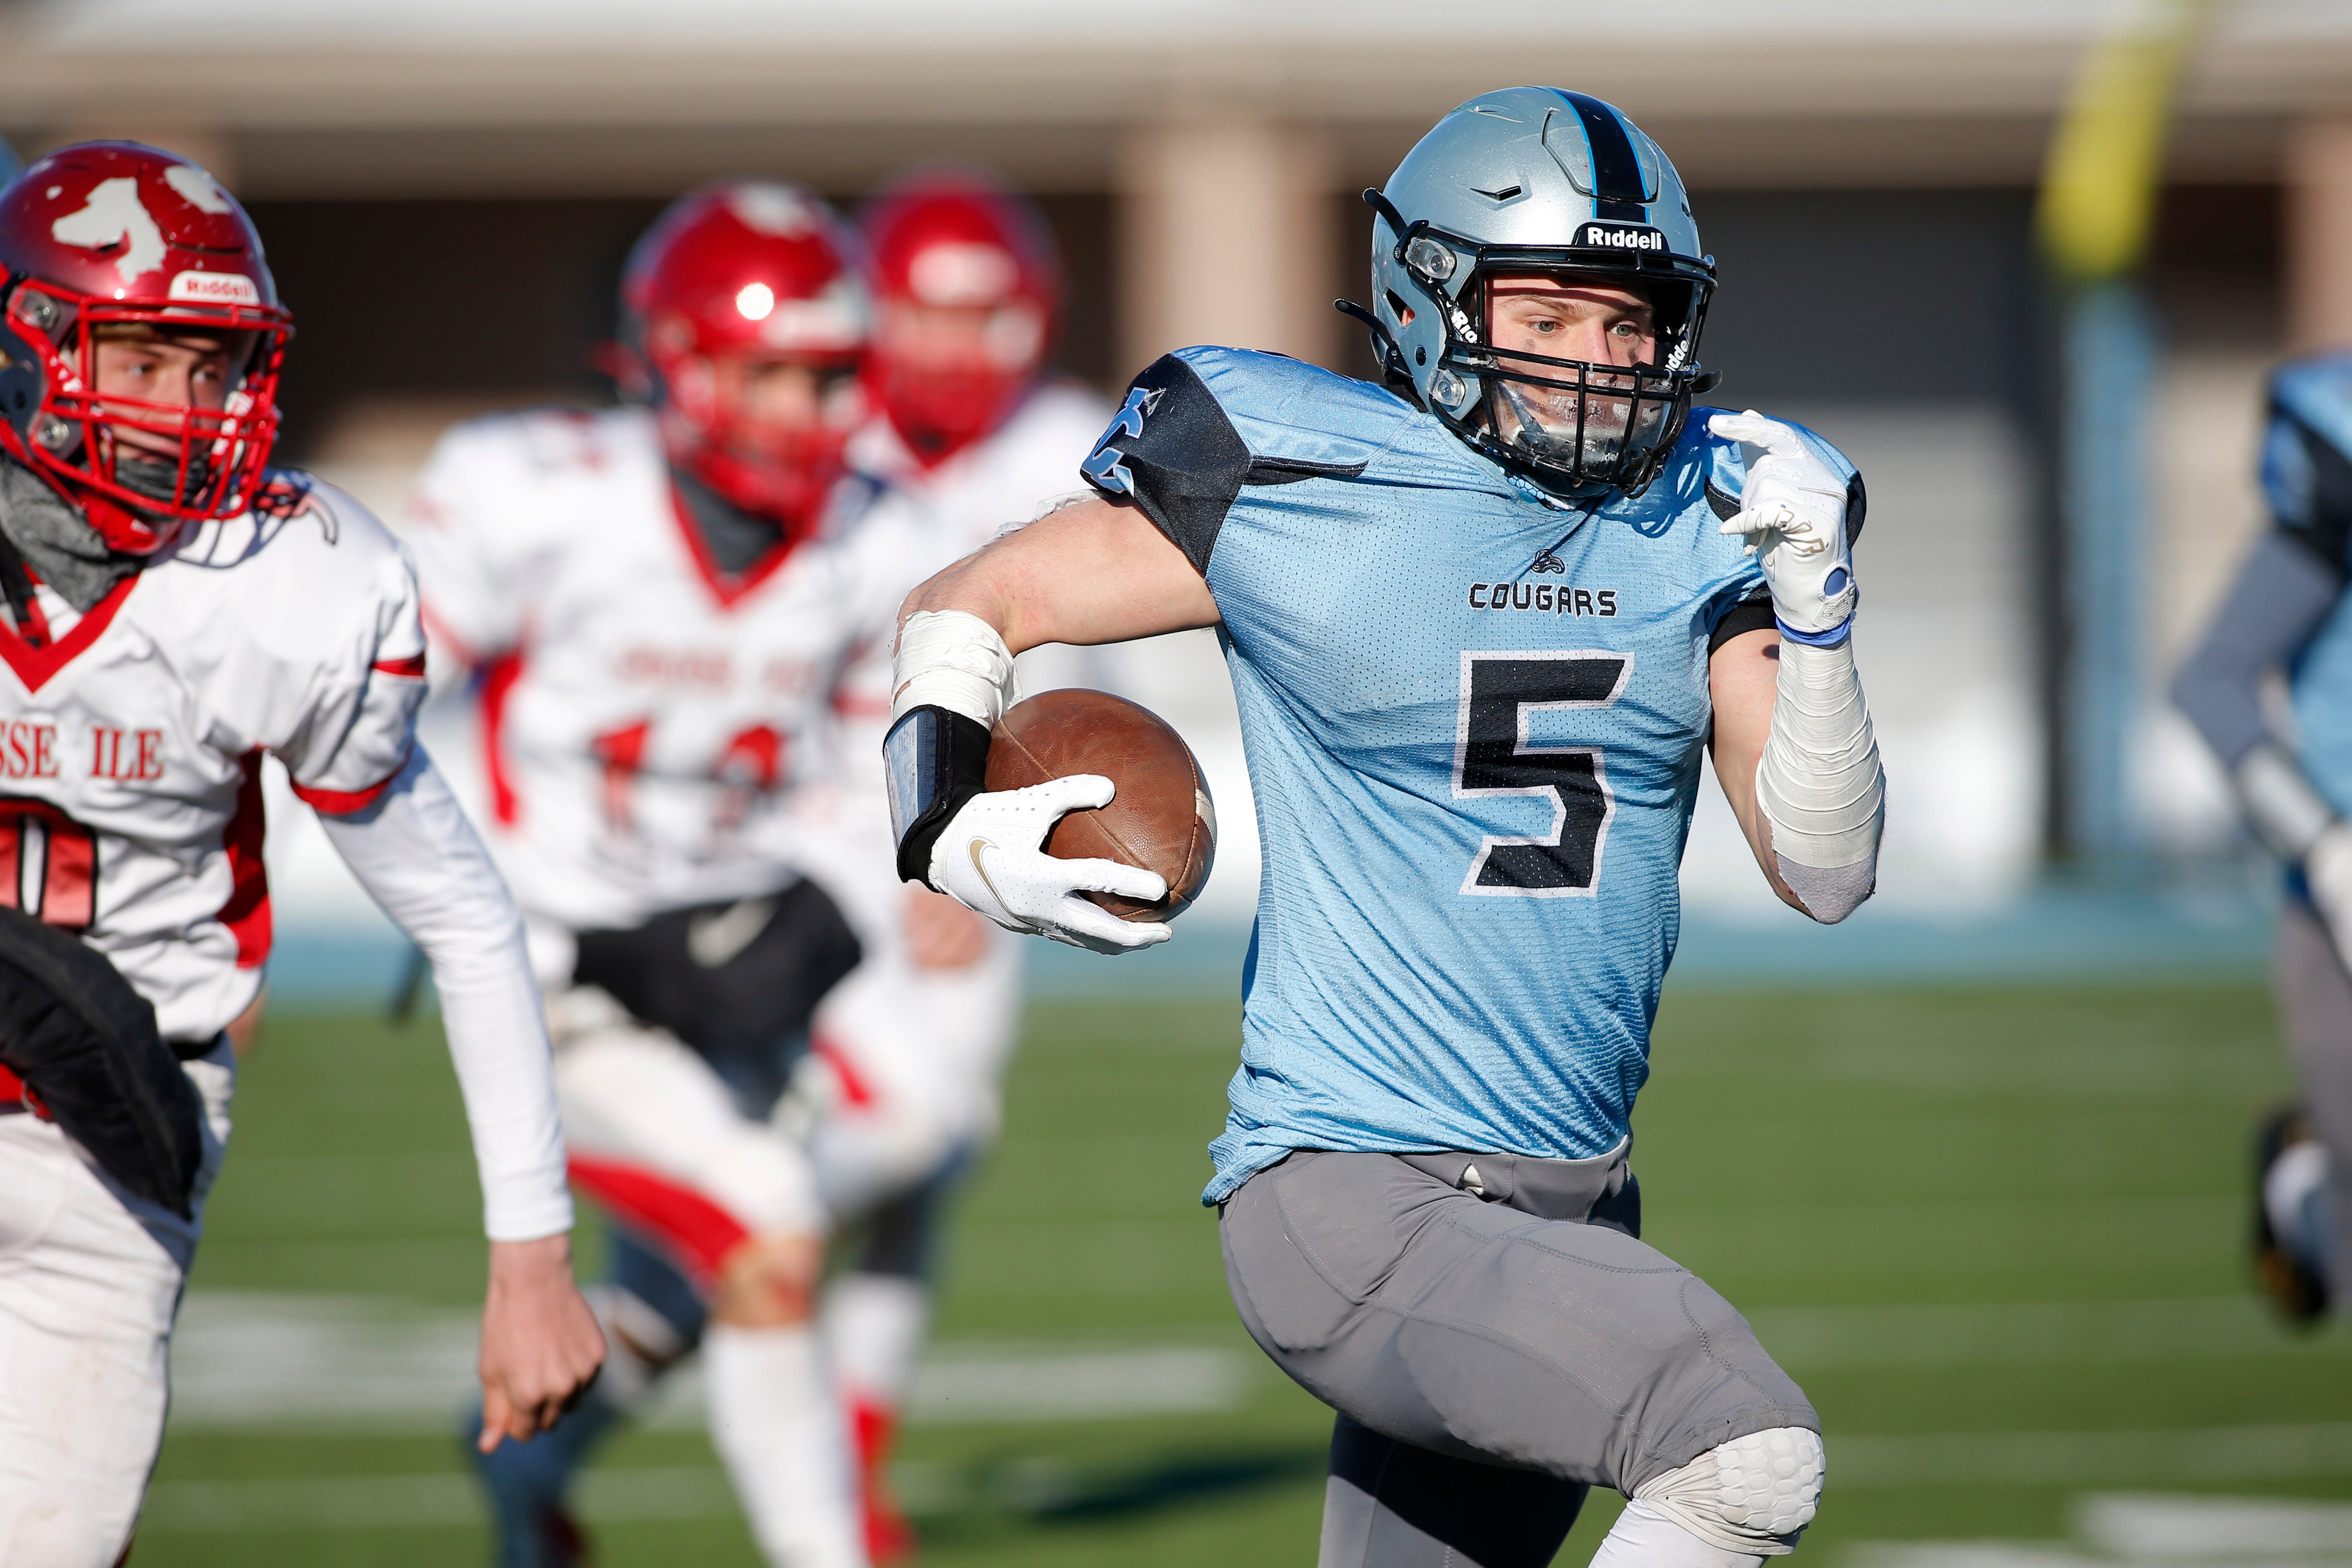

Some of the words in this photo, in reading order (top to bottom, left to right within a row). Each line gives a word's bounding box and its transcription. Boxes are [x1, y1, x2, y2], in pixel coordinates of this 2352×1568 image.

[1588, 227, 1662, 250] Riddell
[1468, 582, 1618, 621] COUGARS
[90, 727, 164, 781] ILE
[1453, 650, 1635, 898] 5
